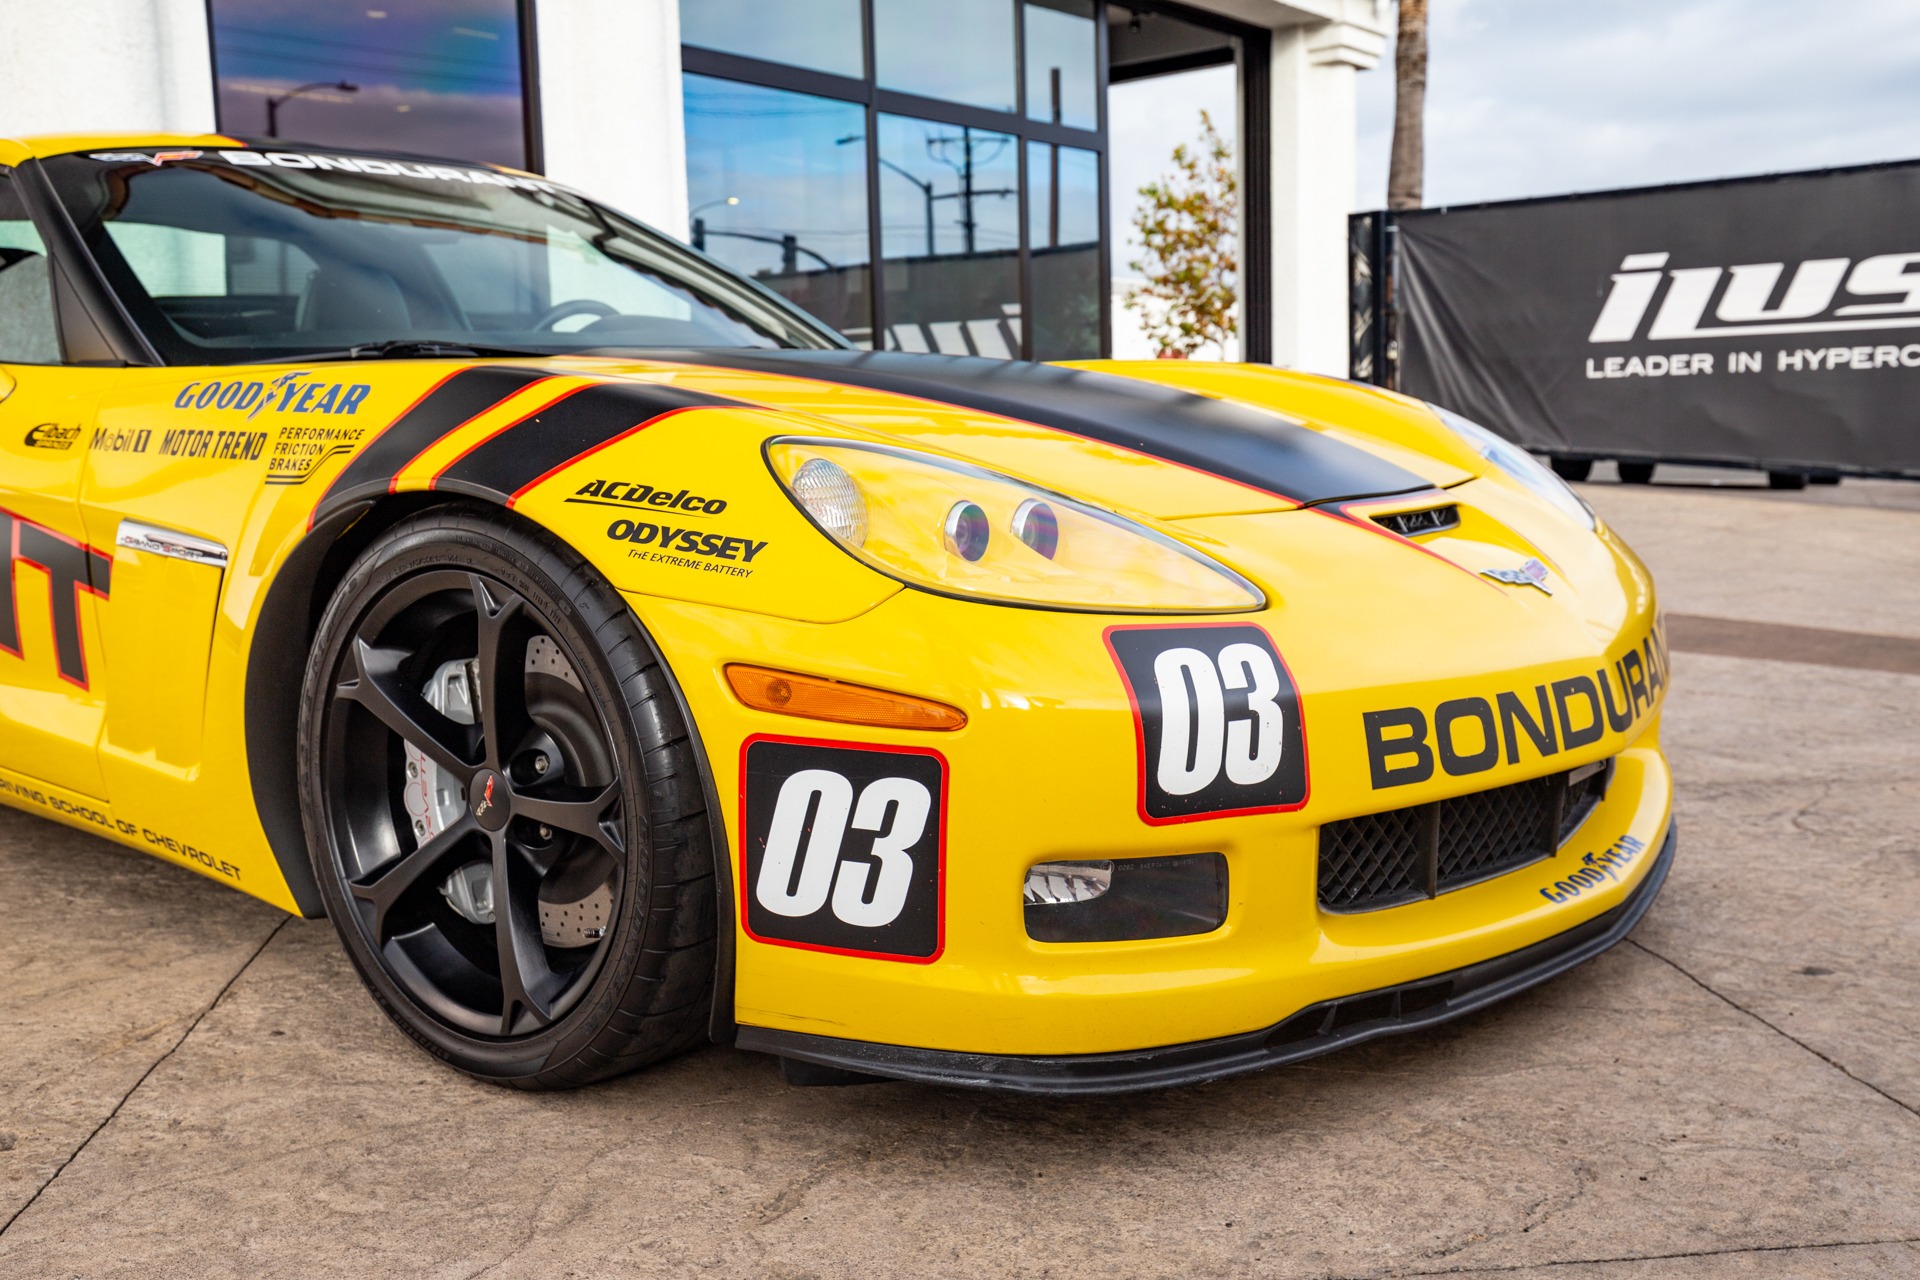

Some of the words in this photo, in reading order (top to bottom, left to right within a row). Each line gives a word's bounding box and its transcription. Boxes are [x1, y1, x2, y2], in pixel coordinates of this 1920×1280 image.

[219, 150, 556, 194] BONDURANT
[1586, 351, 1713, 380] LEADER
[1728, 350, 1762, 374] IN
[174, 377, 371, 418] GOODYEAR
[89, 427, 135, 452] Mobil
[133, 429, 152, 453] 1
[159, 429, 210, 459] MOTOR
[211, 431, 268, 461] TREND
[274, 442, 325, 455] FRICTION
[279, 427, 365, 441] PERFORMANCE
[269, 458, 312, 471] BRAKES
[575, 479, 727, 515] ACDelco
[606, 519, 768, 563] ODYSSEY
[627, 549, 648, 561] THE
[650, 553, 702, 571] EXTREME
[703, 562, 753, 579] BATTERY
[1153, 642, 1284, 795] 03
[49, 795, 115, 829] SCHOOL
[116, 818, 138, 837] OF
[143, 828, 241, 881] CHEVROLET
[755, 769, 932, 928] 03
[1539, 834, 1646, 904] GOODYEAR
